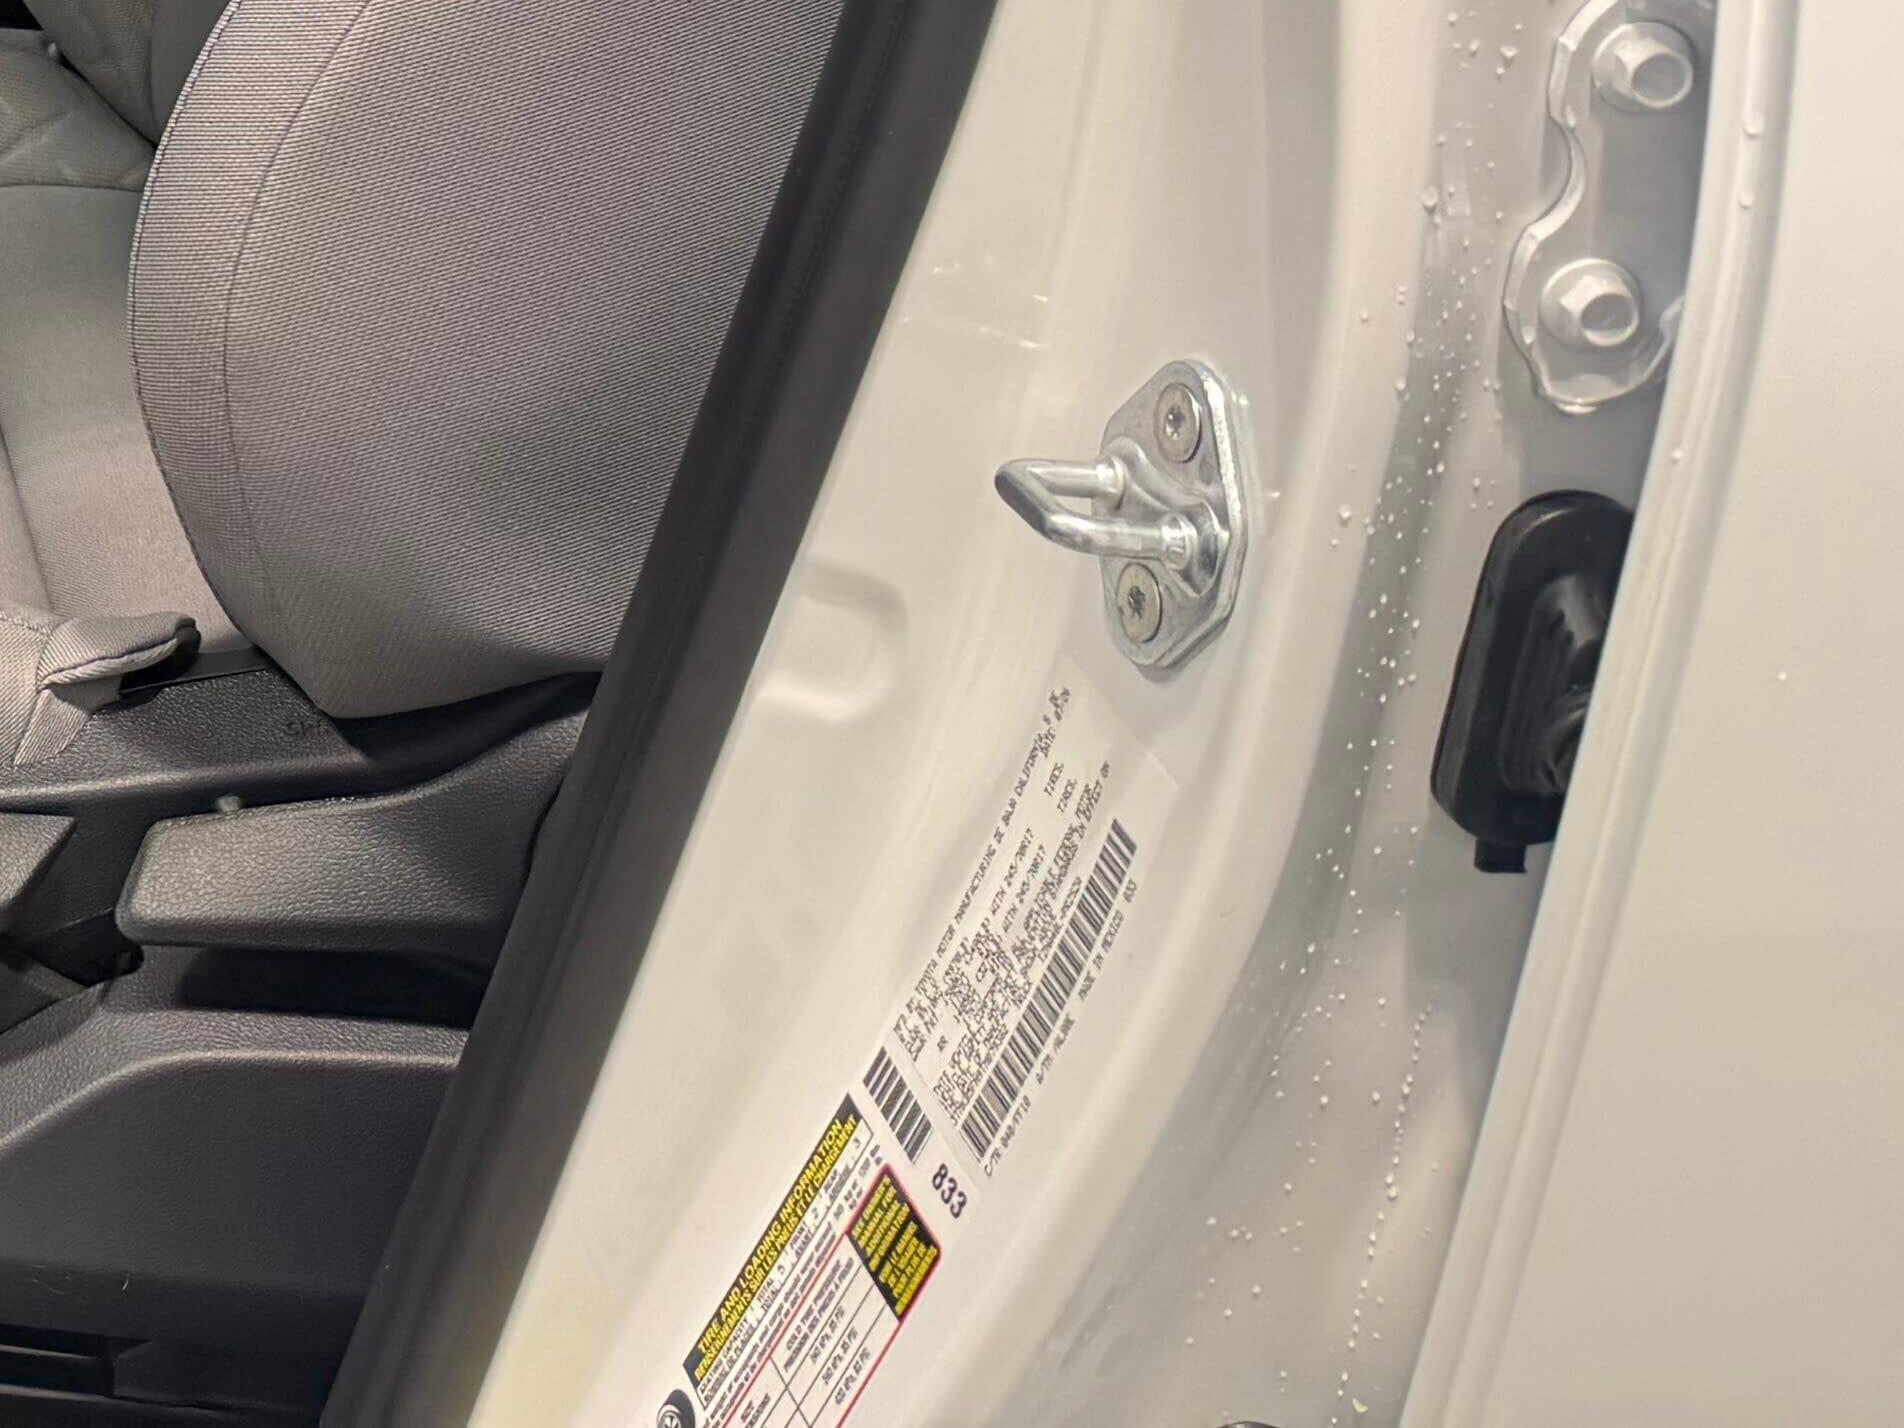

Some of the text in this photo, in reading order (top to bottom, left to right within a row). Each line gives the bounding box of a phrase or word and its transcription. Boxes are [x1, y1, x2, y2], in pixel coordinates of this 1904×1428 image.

[697, 1315, 721, 1356] TIRE
[718, 1284, 741, 1322] AND
[738, 1217, 782, 1289] LOADING
[777, 1117, 843, 1223] INFORMATION
[933, 1163, 967, 1219] 833
